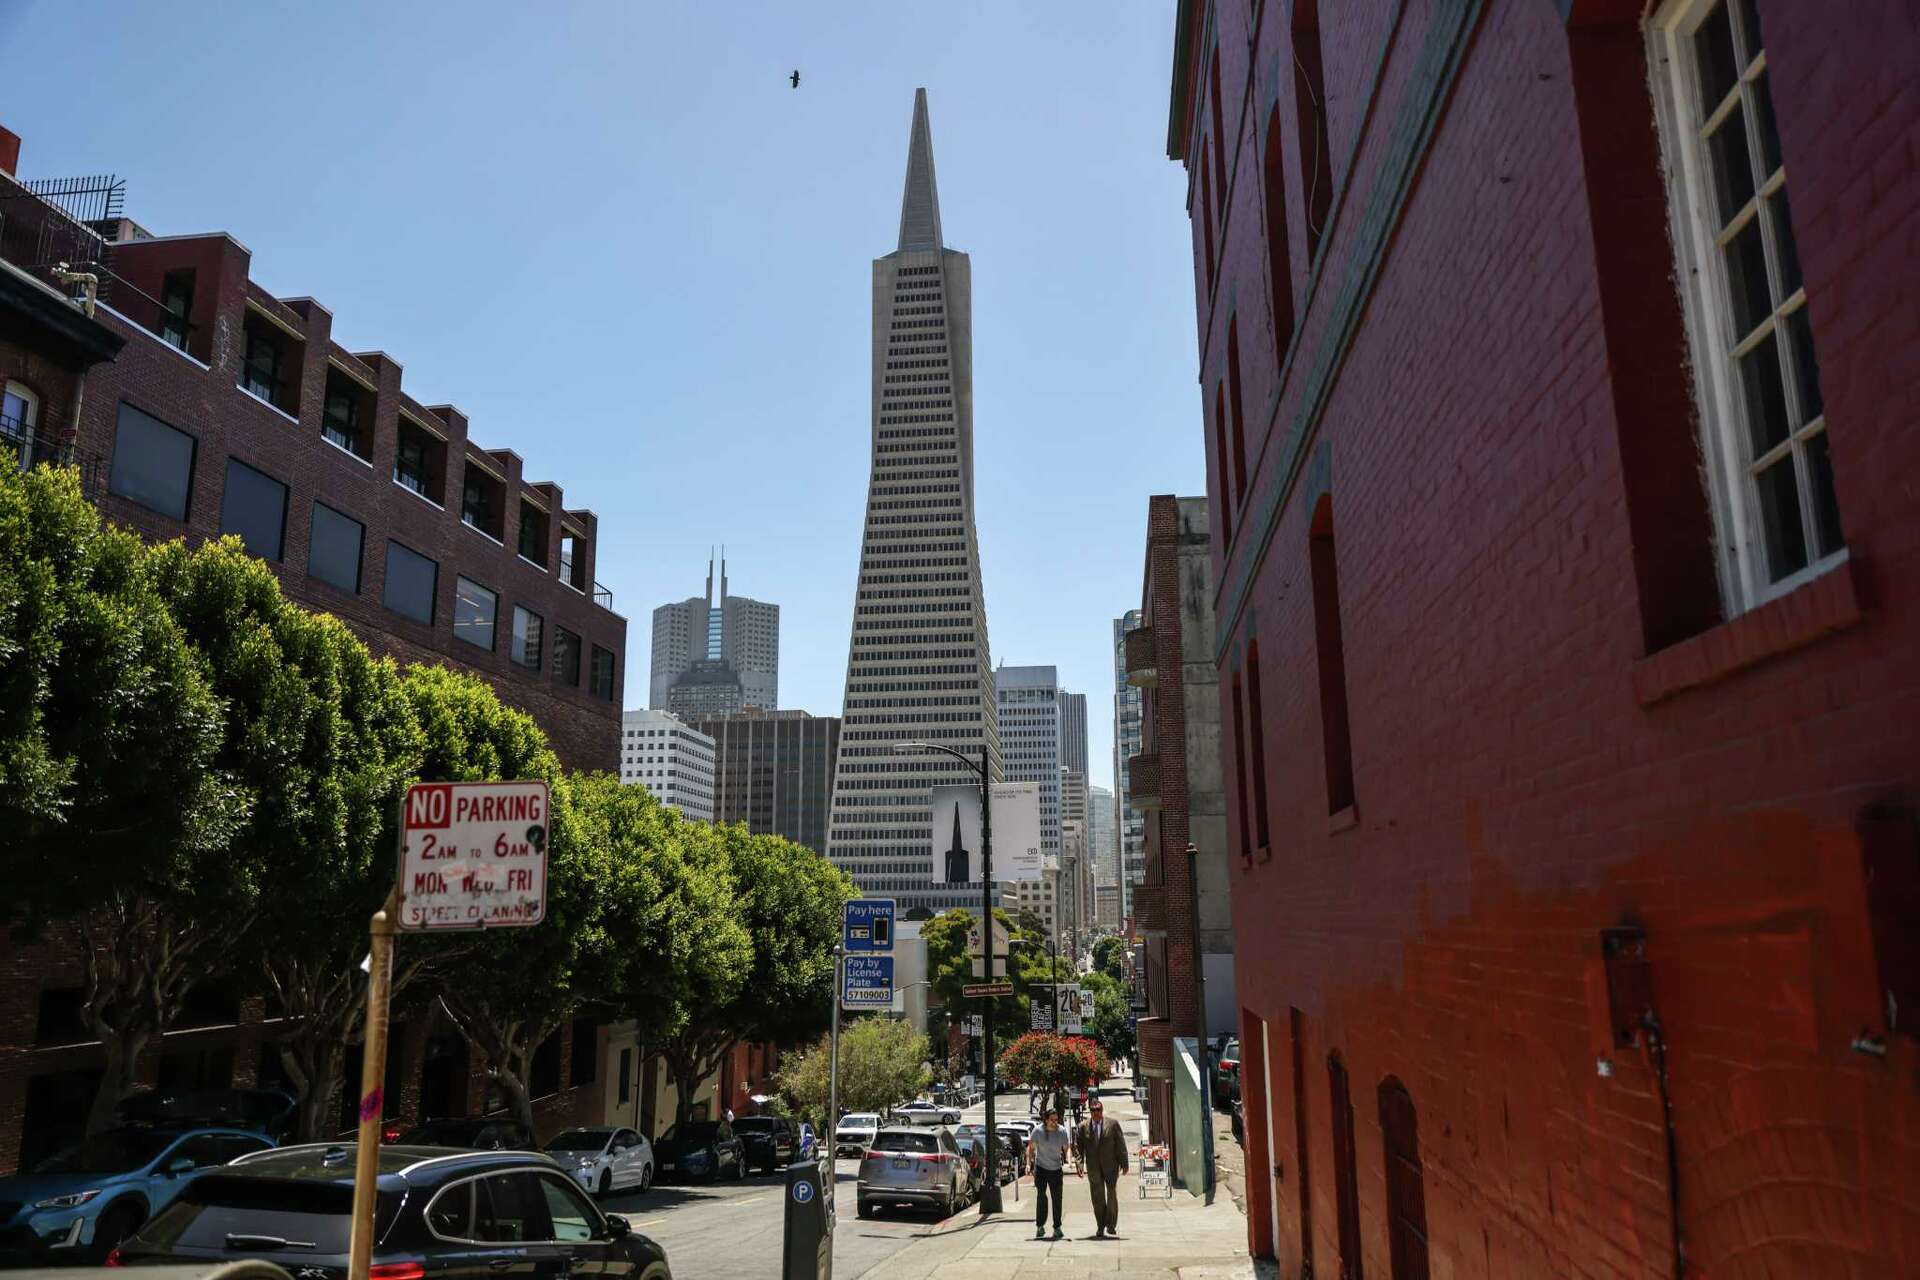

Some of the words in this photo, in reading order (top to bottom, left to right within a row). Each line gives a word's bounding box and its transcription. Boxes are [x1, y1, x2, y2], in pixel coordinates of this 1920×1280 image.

[411, 790, 446, 825] NO
[456, 795, 541, 823] PARKING
[470, 847, 481, 859] TO
[507, 869, 532, 892] FRI
[848, 904, 865, 917] Pay
[868, 904, 892, 916] here
[847, 958, 865, 969] Pay
[867, 957, 880, 968] by
[847, 967, 882, 977] License
[847, 979, 871, 988] Plate
[848, 990, 889, 1000] 57109003
